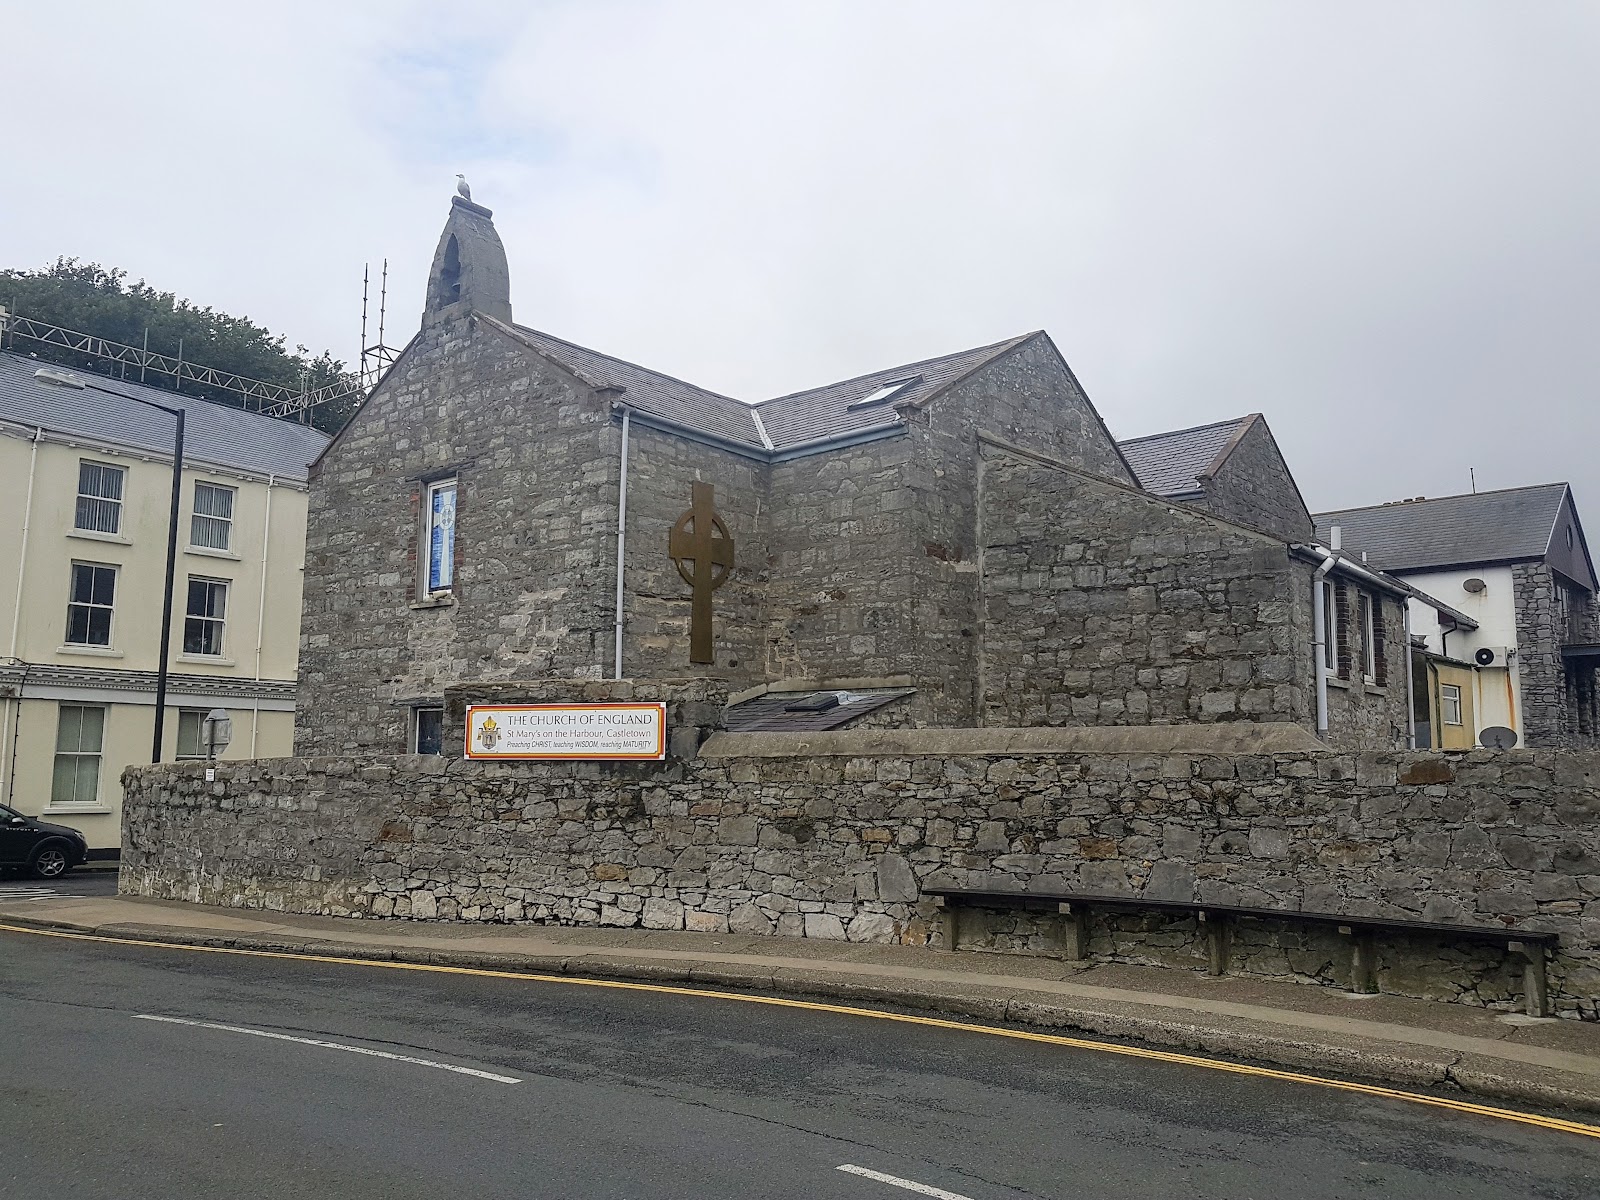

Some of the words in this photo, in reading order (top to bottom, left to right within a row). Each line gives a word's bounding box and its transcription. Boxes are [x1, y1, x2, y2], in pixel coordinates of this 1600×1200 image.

[508, 715, 527, 725] THE
[530, 715, 576, 725] CHURCH
[580, 714, 595, 725] OF
[598, 714, 652, 725] ENGLAND
[516, 730, 541, 740] Mary's
[555, 729, 568, 738] the
[570, 729, 604, 738] Harbour,
[607, 729, 651, 738] Castletown
[506, 741, 531, 750] Preaching
[553, 741, 574, 750] teaching
[601, 741, 622, 749] reaching
